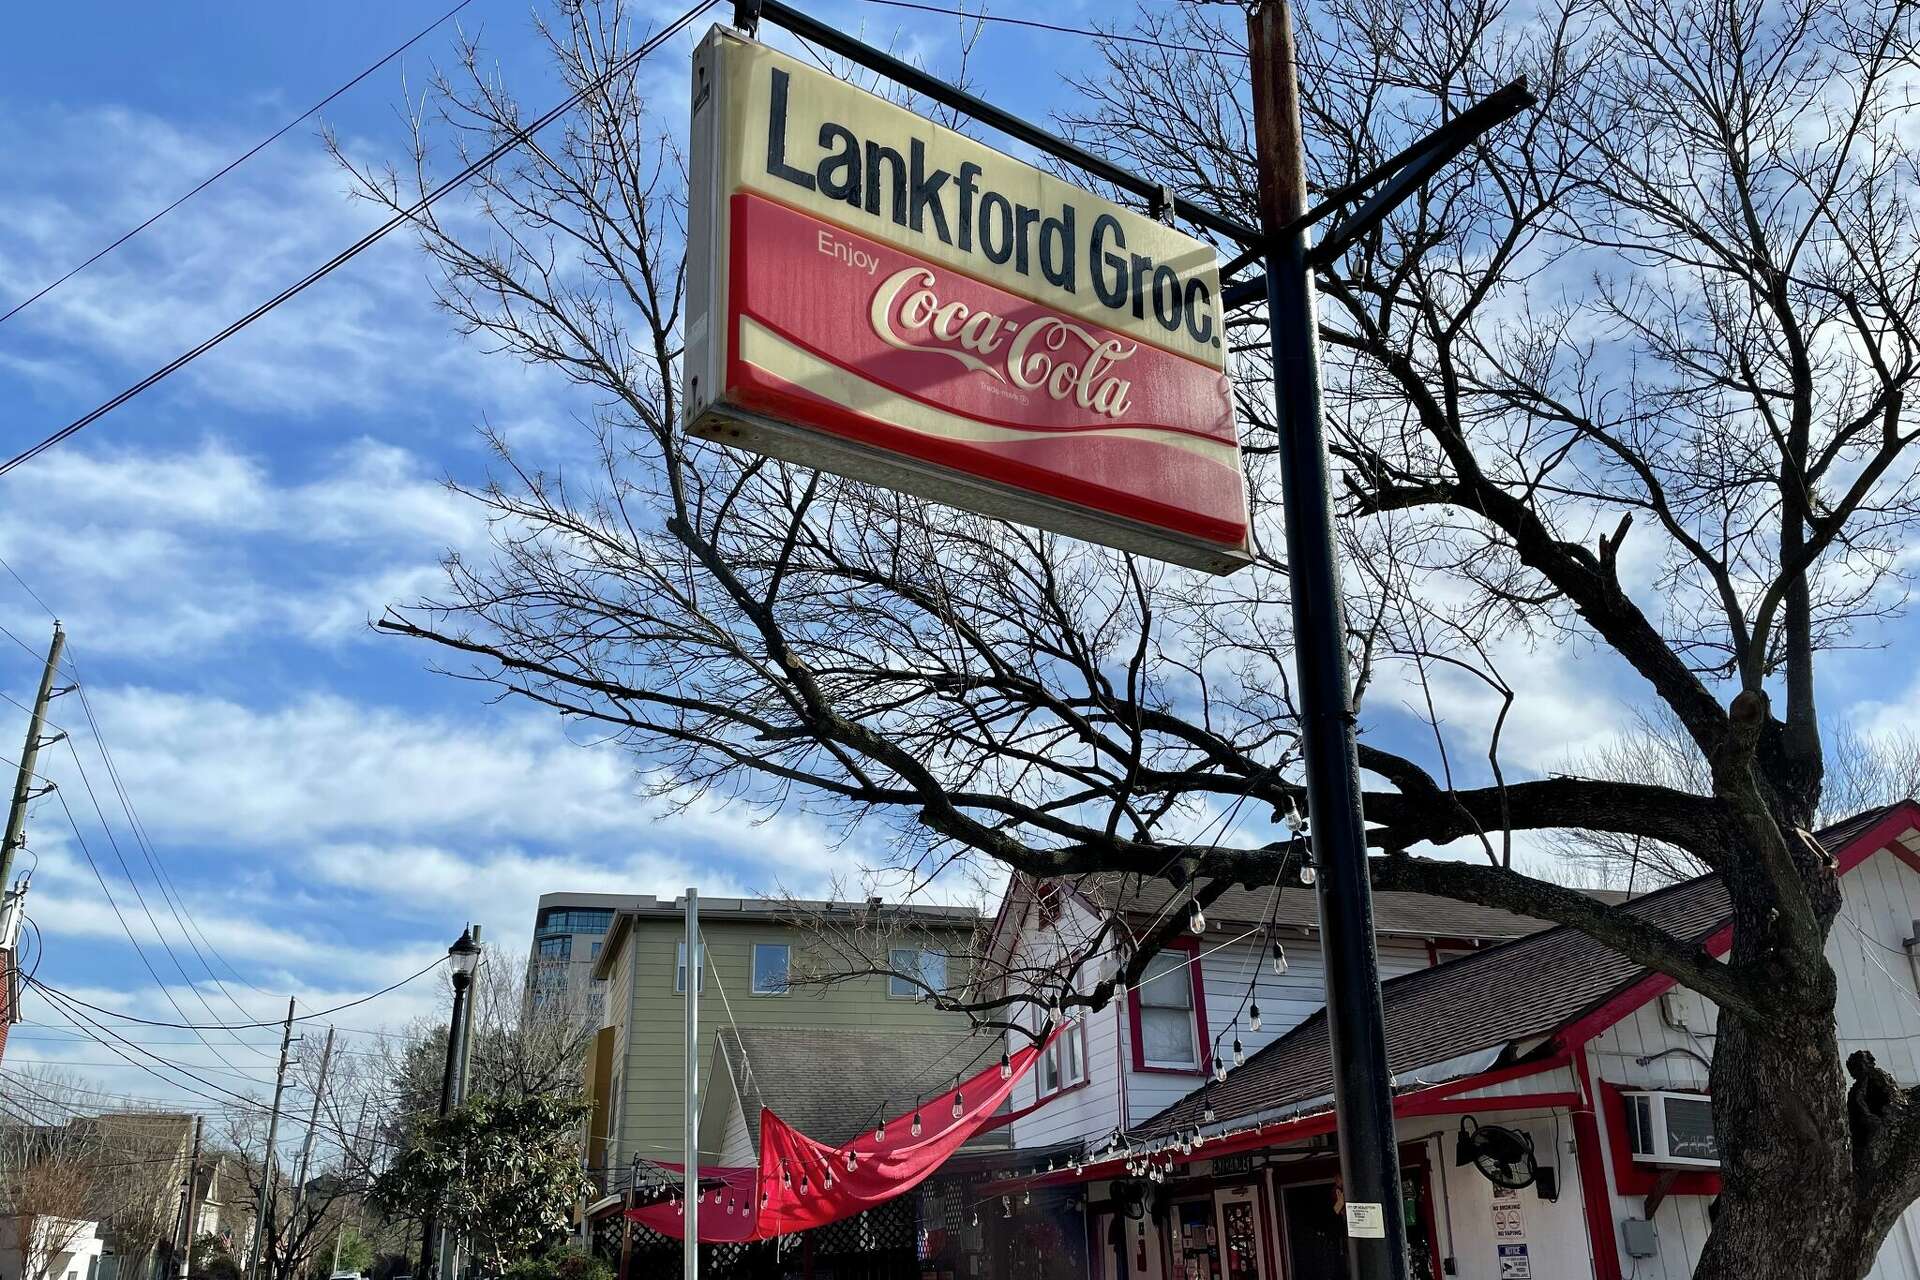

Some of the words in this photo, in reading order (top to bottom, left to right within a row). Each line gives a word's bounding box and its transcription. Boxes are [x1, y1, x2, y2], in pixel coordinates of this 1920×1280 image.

[767, 67, 1076, 295] Lankford
[1090, 214, 1221, 349] Groc.
[818, 230, 880, 276] Enjoy
[871, 267, 1137, 418] Coca-Cola
